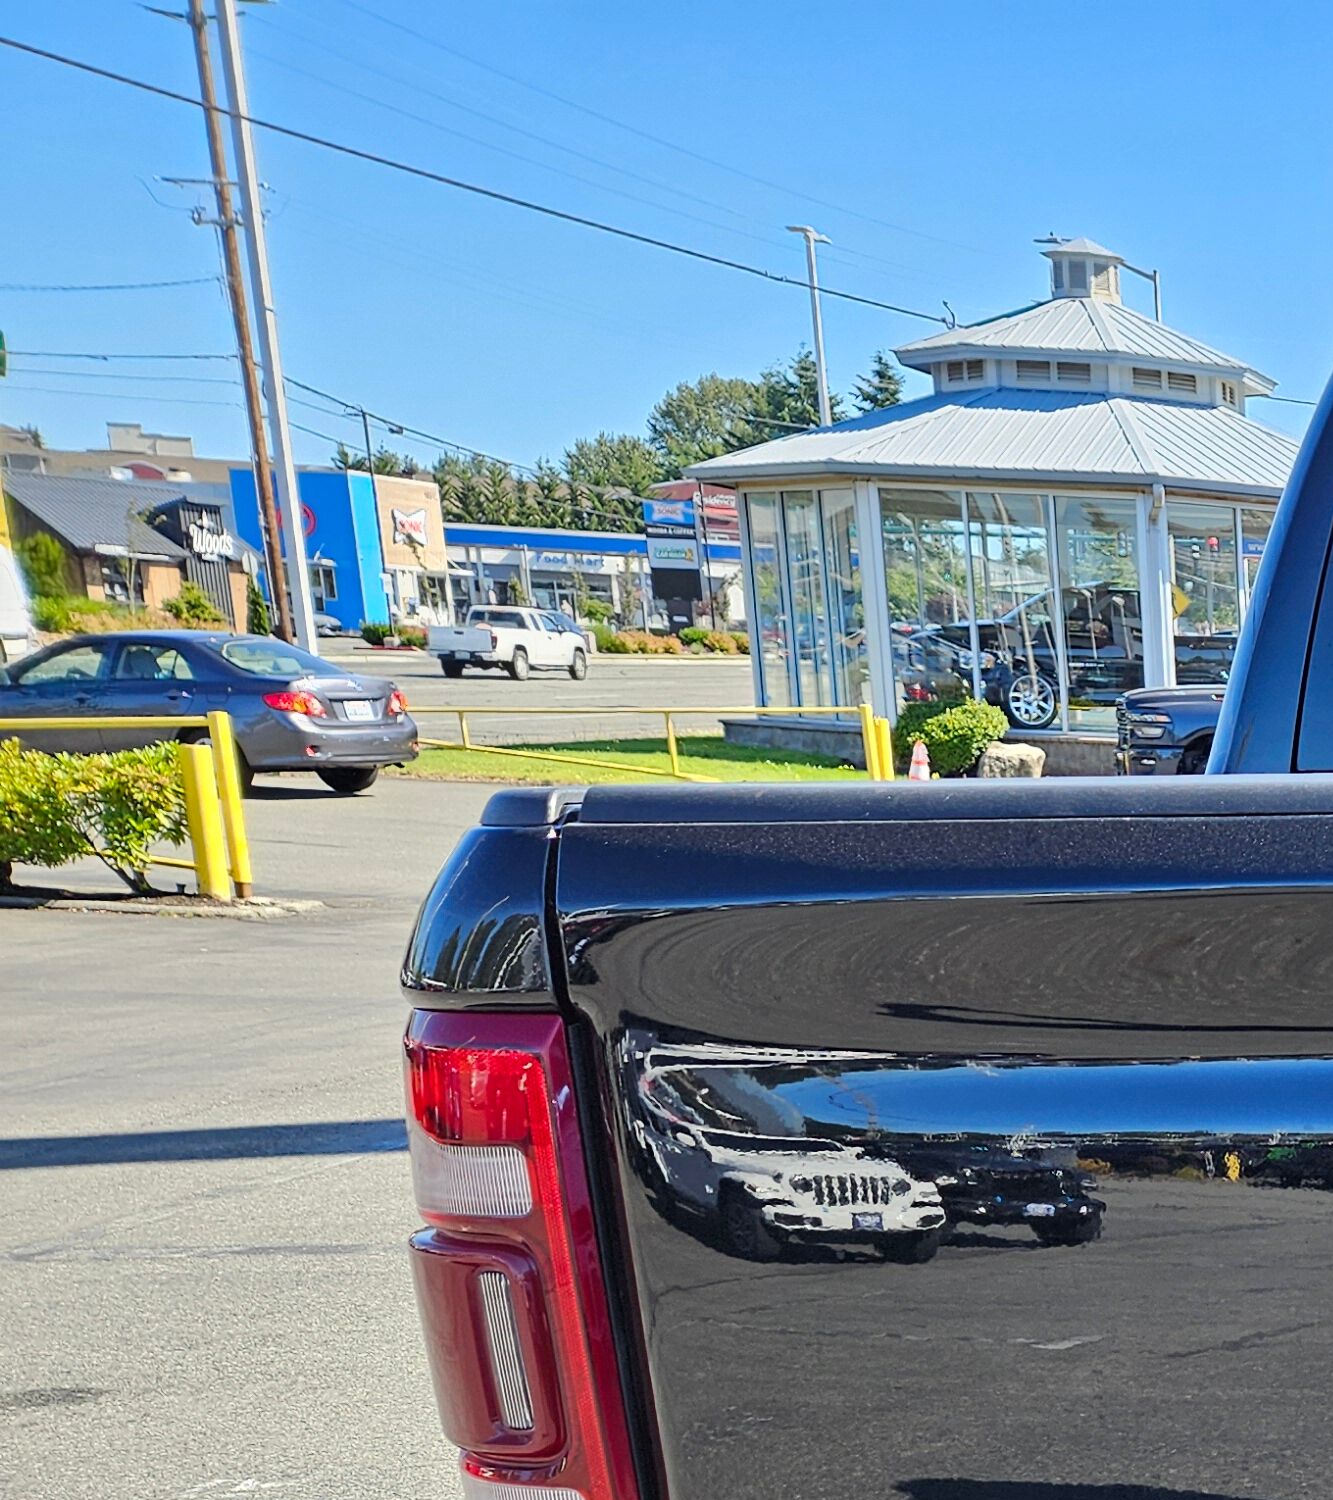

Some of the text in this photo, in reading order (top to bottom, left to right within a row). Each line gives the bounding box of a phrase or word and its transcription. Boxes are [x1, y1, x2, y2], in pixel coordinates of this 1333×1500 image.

[189, 523, 233, 555] Woods
[536, 554, 604, 567] Food Mart
